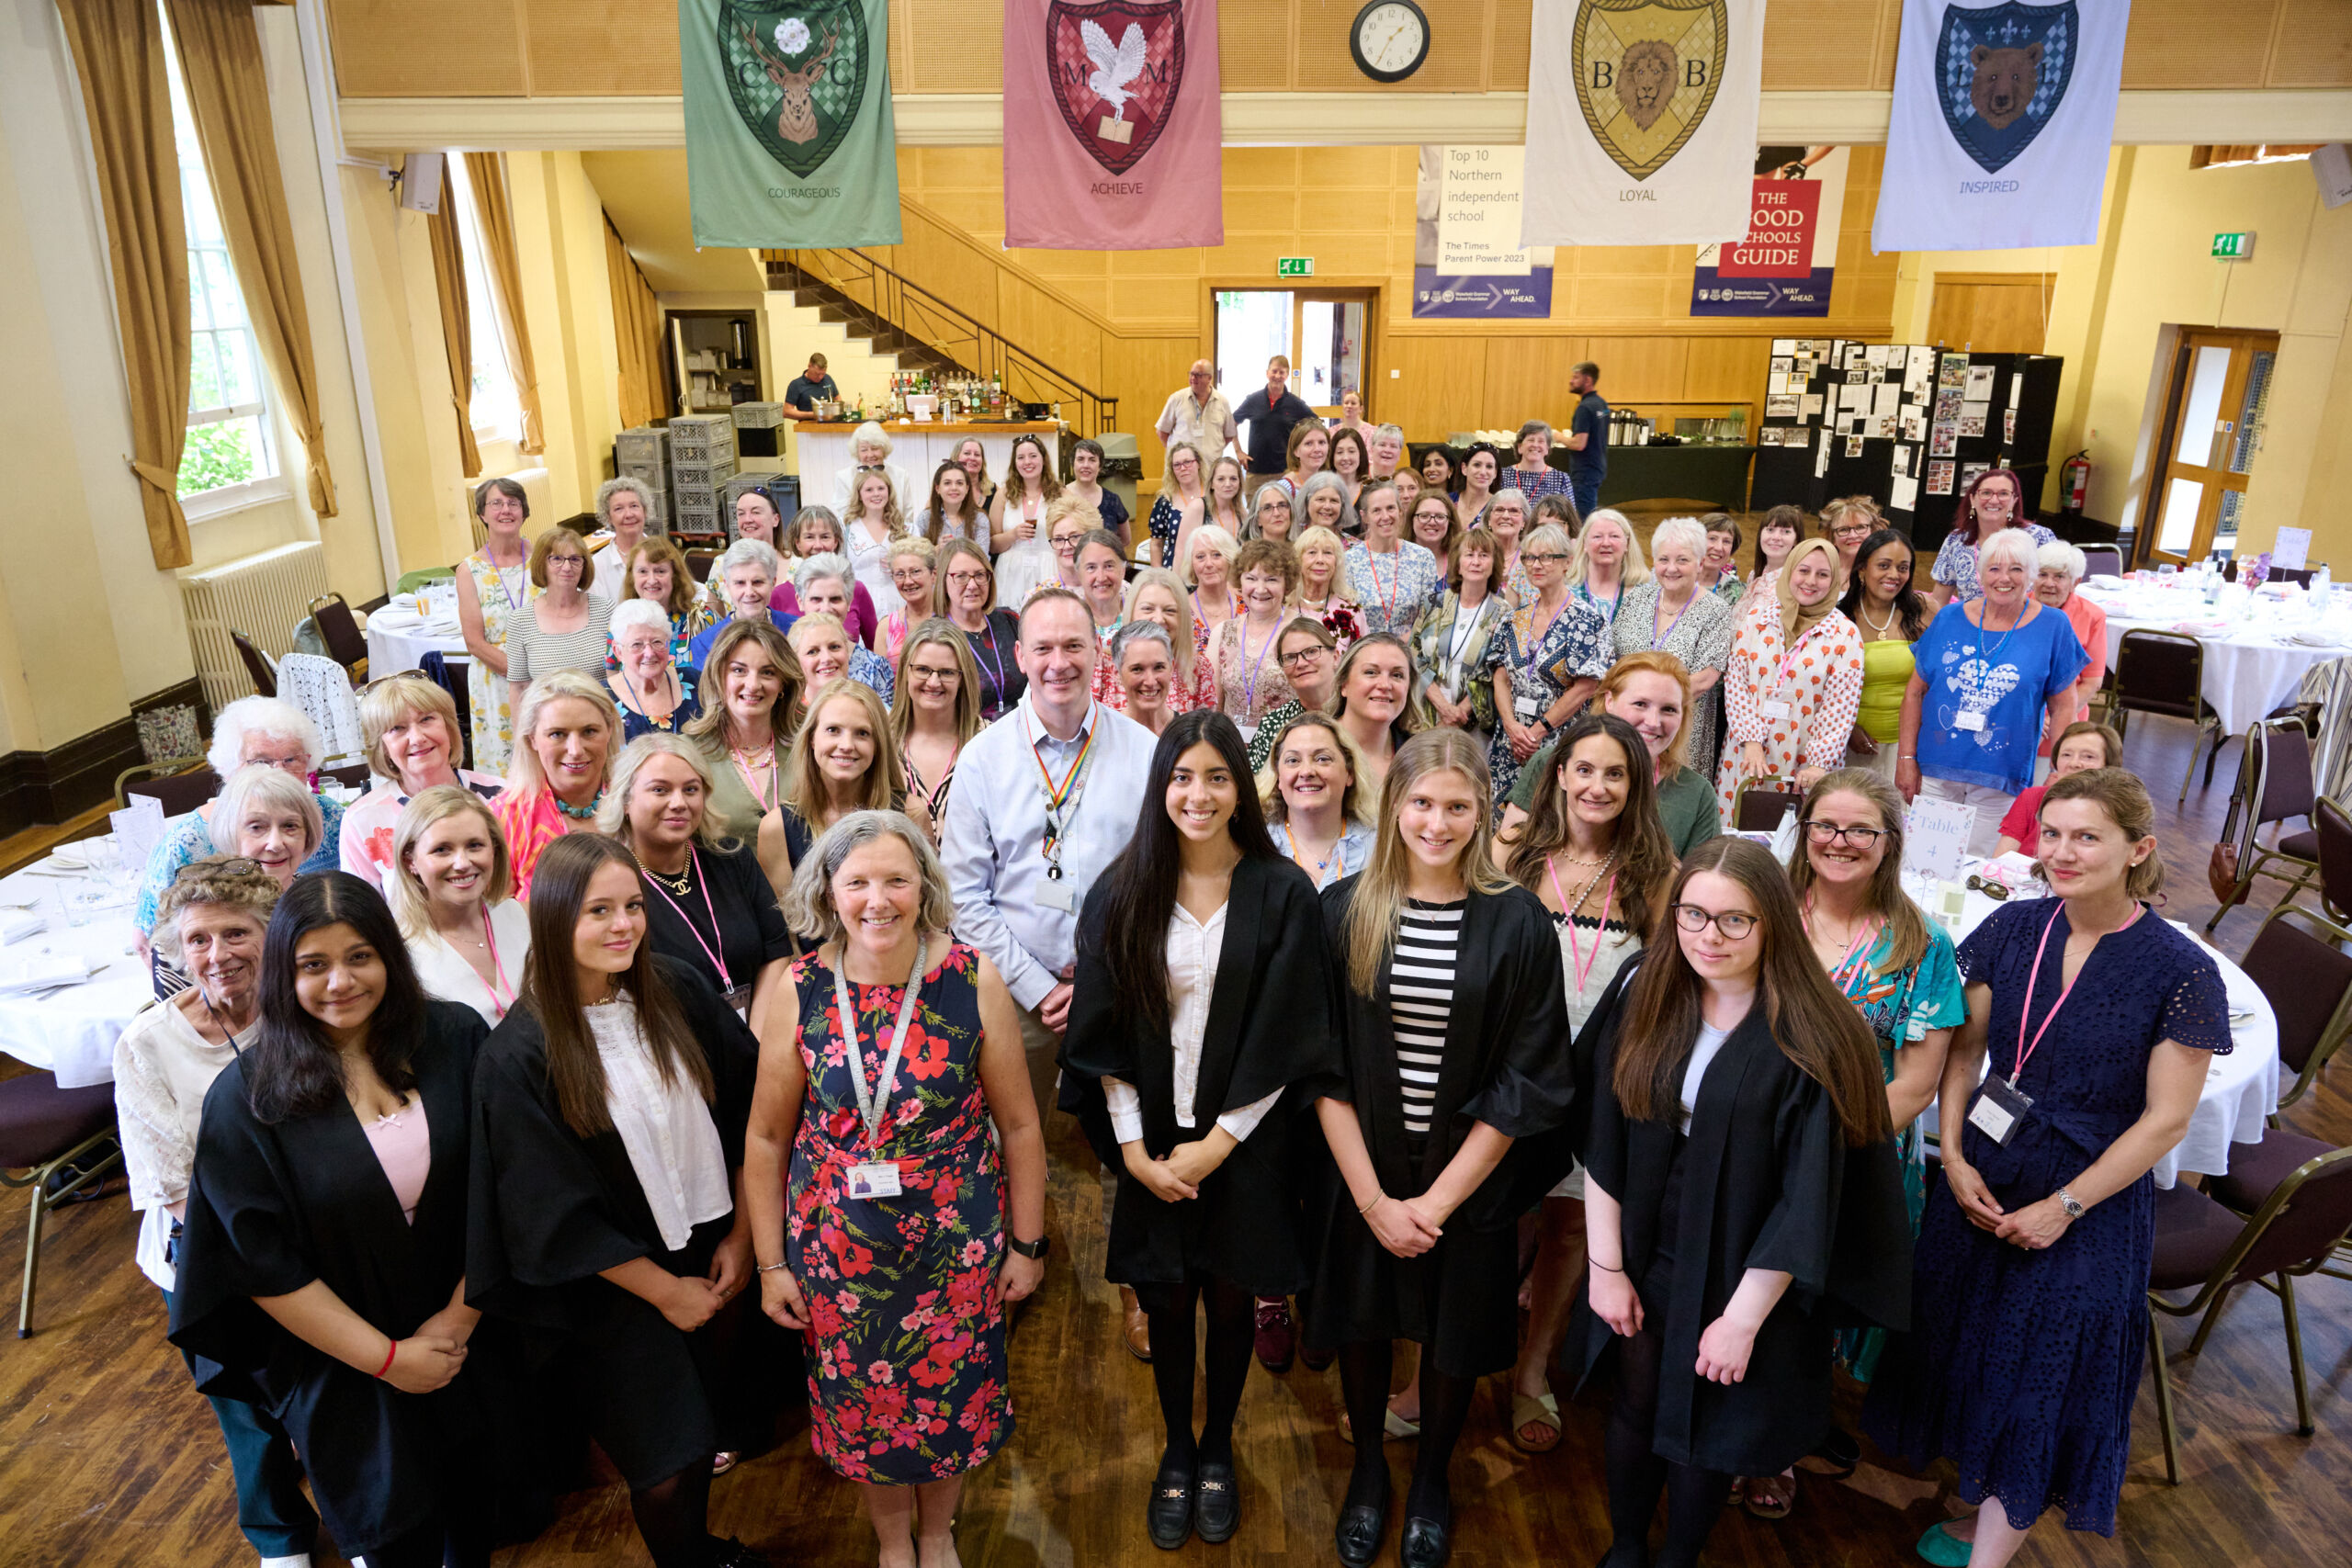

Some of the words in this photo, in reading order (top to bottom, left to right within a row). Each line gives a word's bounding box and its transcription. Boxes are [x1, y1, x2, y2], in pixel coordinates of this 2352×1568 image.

[739, 61, 763, 88] C
[831, 58, 853, 86] C
[1065, 62, 1088, 86] M
[1146, 59, 1170, 85] M
[1591, 61, 1612, 88] B
[1685, 60, 1705, 87] B
[1956, 64, 1970, 87] L
[1450, 150, 1470, 164] Top
[1476, 150, 1489, 161] 10
[1449, 169, 1502, 180] Northern
[768, 187, 841, 198] COURAGEOUS
[1091, 183, 1143, 195] ACHIEVE
[1959, 180, 2019, 194] INSPIRED
[1448, 191, 1520, 205] independent
[1619, 189, 1657, 201] LOYAL
[1758, 193, 1788, 204] THE
[1448, 210, 1485, 221] school
[1751, 209, 1804, 227] OOD
[1744, 231, 1801, 243] CHOOLS
[1444, 254, 1473, 263] Parent
[1476, 254, 1502, 263] Power
[1504, 254, 1524, 263] 2023
[1733, 249, 1799, 265] GUIDE
[1919, 815, 1959, 835] Table
[1928, 845, 1937, 857] 4
